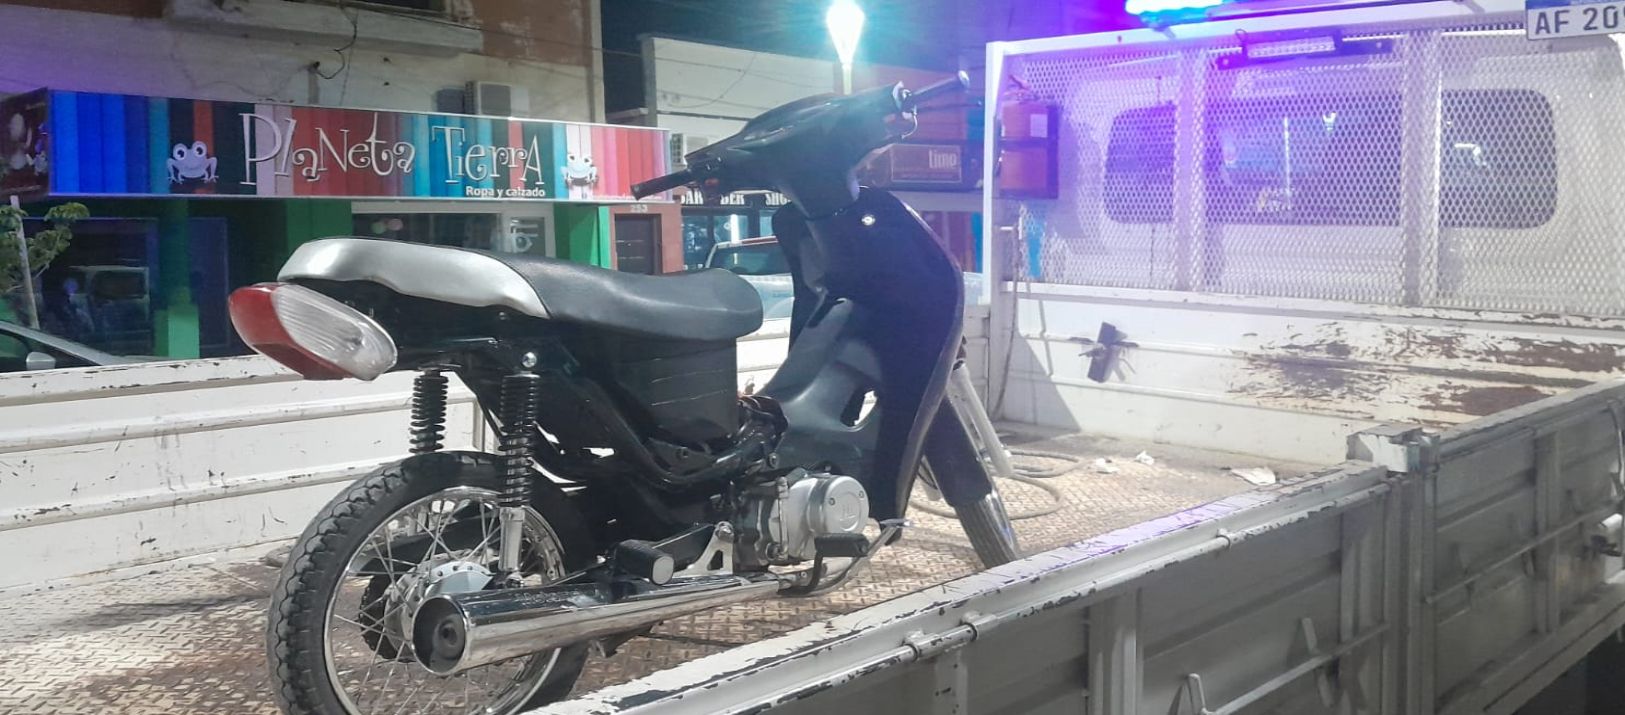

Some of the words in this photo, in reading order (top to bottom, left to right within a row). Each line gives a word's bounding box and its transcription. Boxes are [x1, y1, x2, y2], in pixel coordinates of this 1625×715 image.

[1535, 9, 1570, 35] AF
[1582, 5, 1625, 31] 20
[465, 185, 495, 199] Ropa
[497, 187, 504, 200] y
[505, 186, 546, 198] calzado
